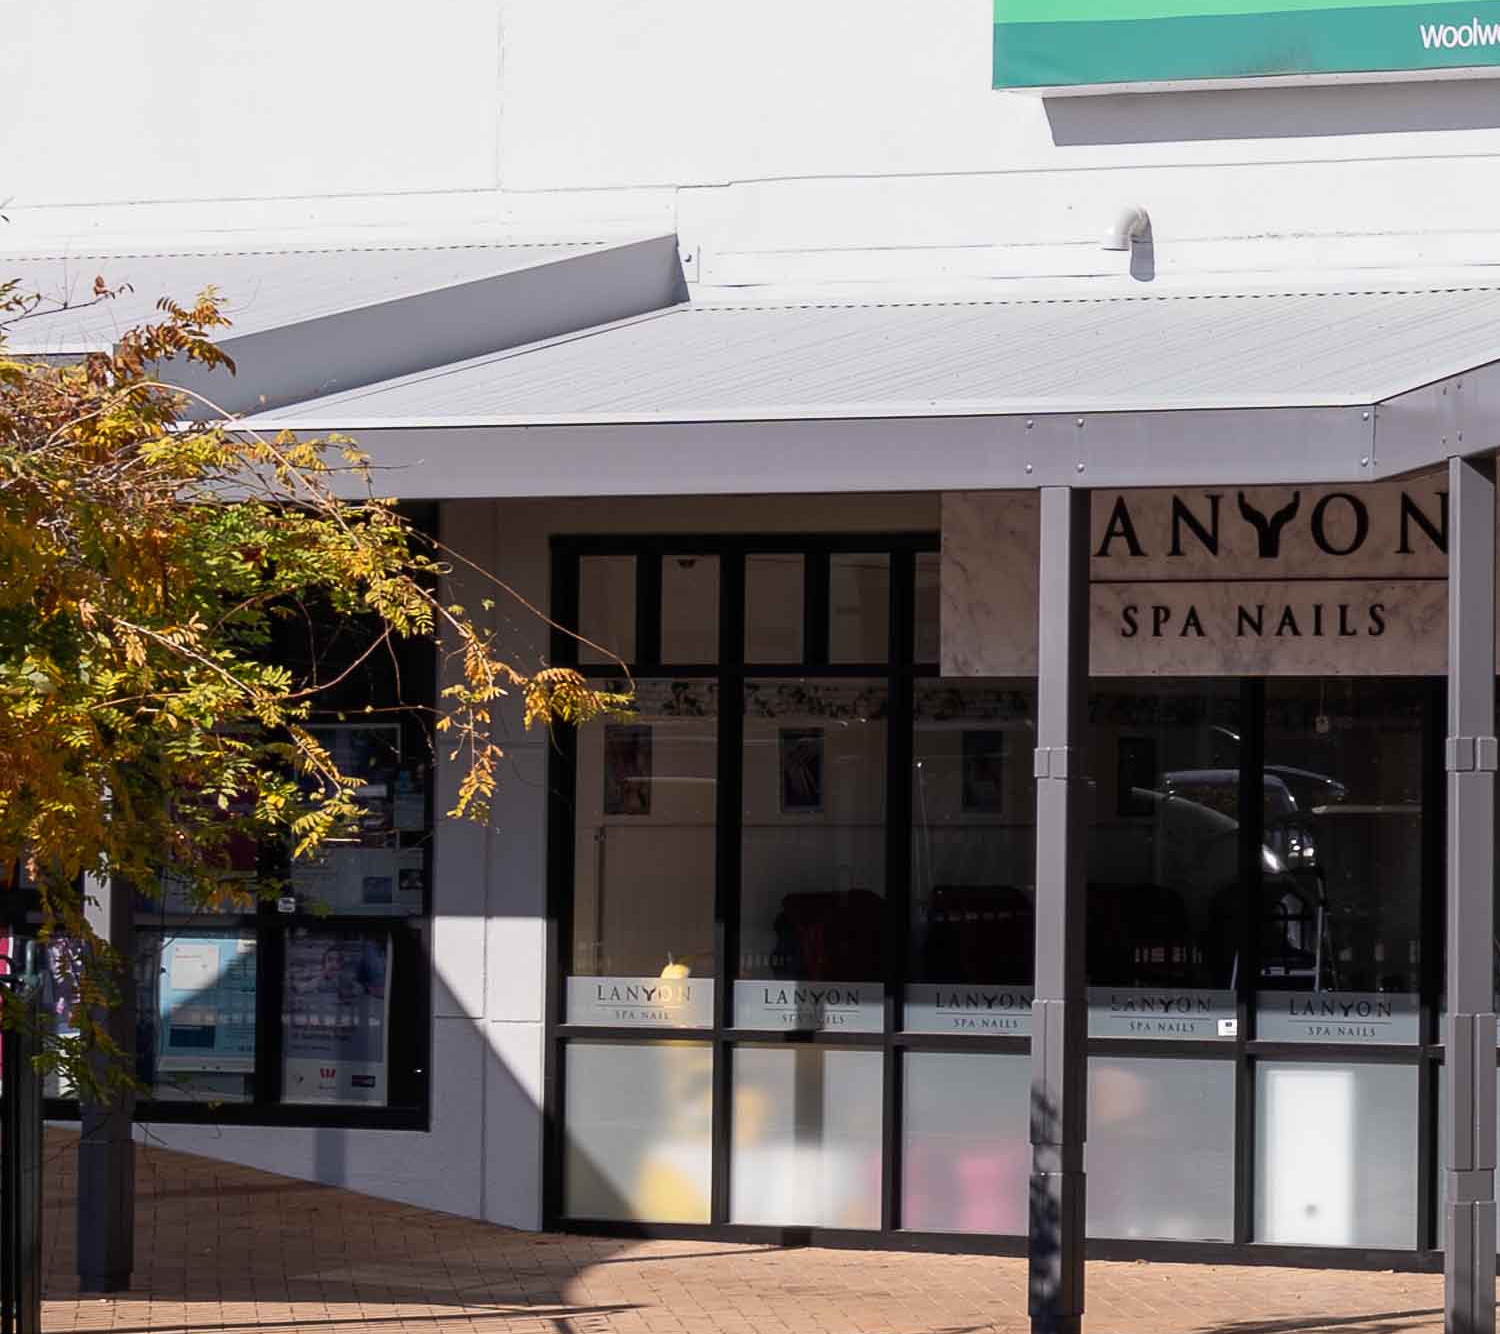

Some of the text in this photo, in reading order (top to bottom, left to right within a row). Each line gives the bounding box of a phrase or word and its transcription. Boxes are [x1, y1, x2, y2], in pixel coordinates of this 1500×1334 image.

[1093, 491, 1448, 557] ANYON
[1121, 604, 1385, 637] SPA NAILS
[764, 988, 860, 1006] LANYON
[936, 992, 1033, 1010] LANYON
[1112, 995, 1211, 1013] LANYON
[640, 1011, 669, 1020] NAIL
[1288, 999, 1391, 1017] LANYON
[953, 1018, 1018, 1029] SPA NAILS
[1130, 1022, 1195, 1032] SPA NAILS
[1309, 1027, 1376, 1037] SPA NAILS
